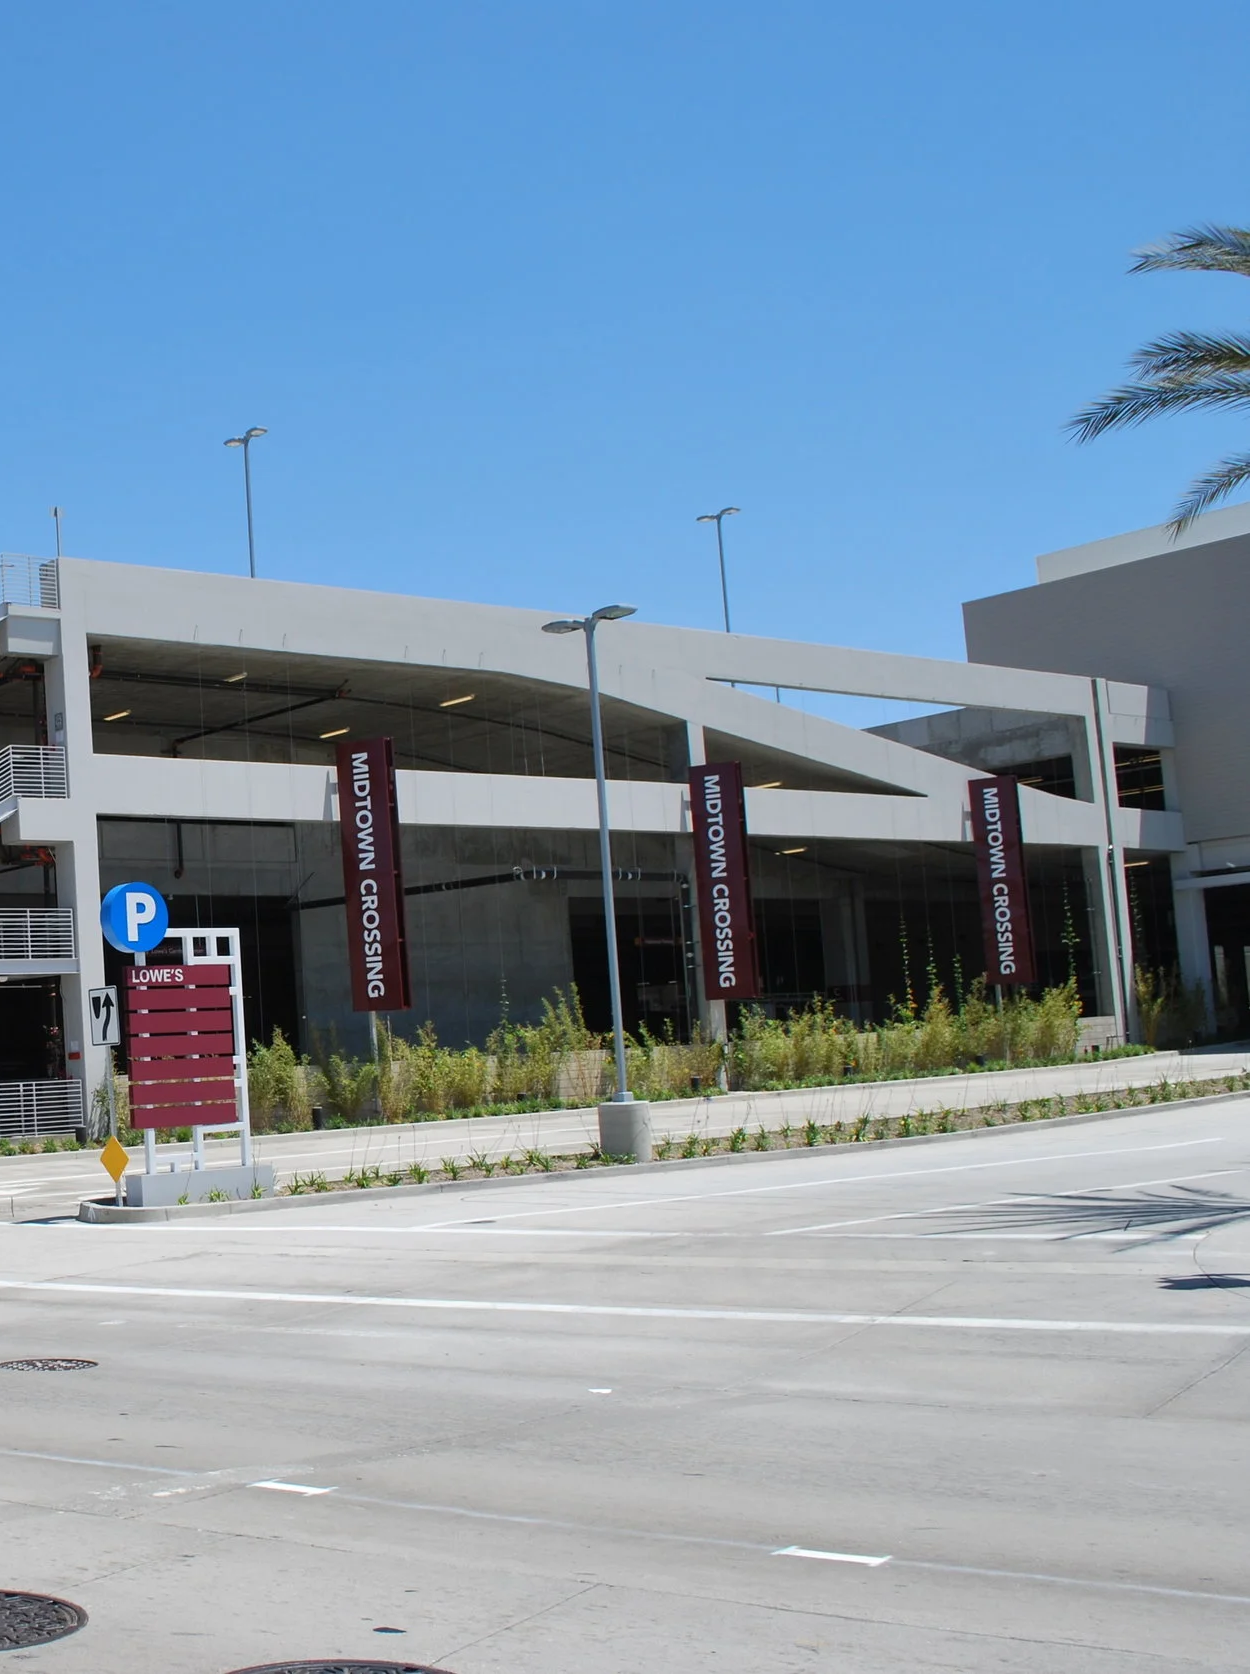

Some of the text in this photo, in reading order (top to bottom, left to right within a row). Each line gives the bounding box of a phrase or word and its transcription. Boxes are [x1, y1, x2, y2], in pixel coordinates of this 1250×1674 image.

[125, 891, 157, 942] P
[351, 751, 385, 998] MIDTOWN CROSSING
[703, 774, 736, 988] MIDTOWN CROSSING
[983, 787, 1016, 975] MIDTOWN CROSSING
[131, 968, 184, 983] LOWE'S
